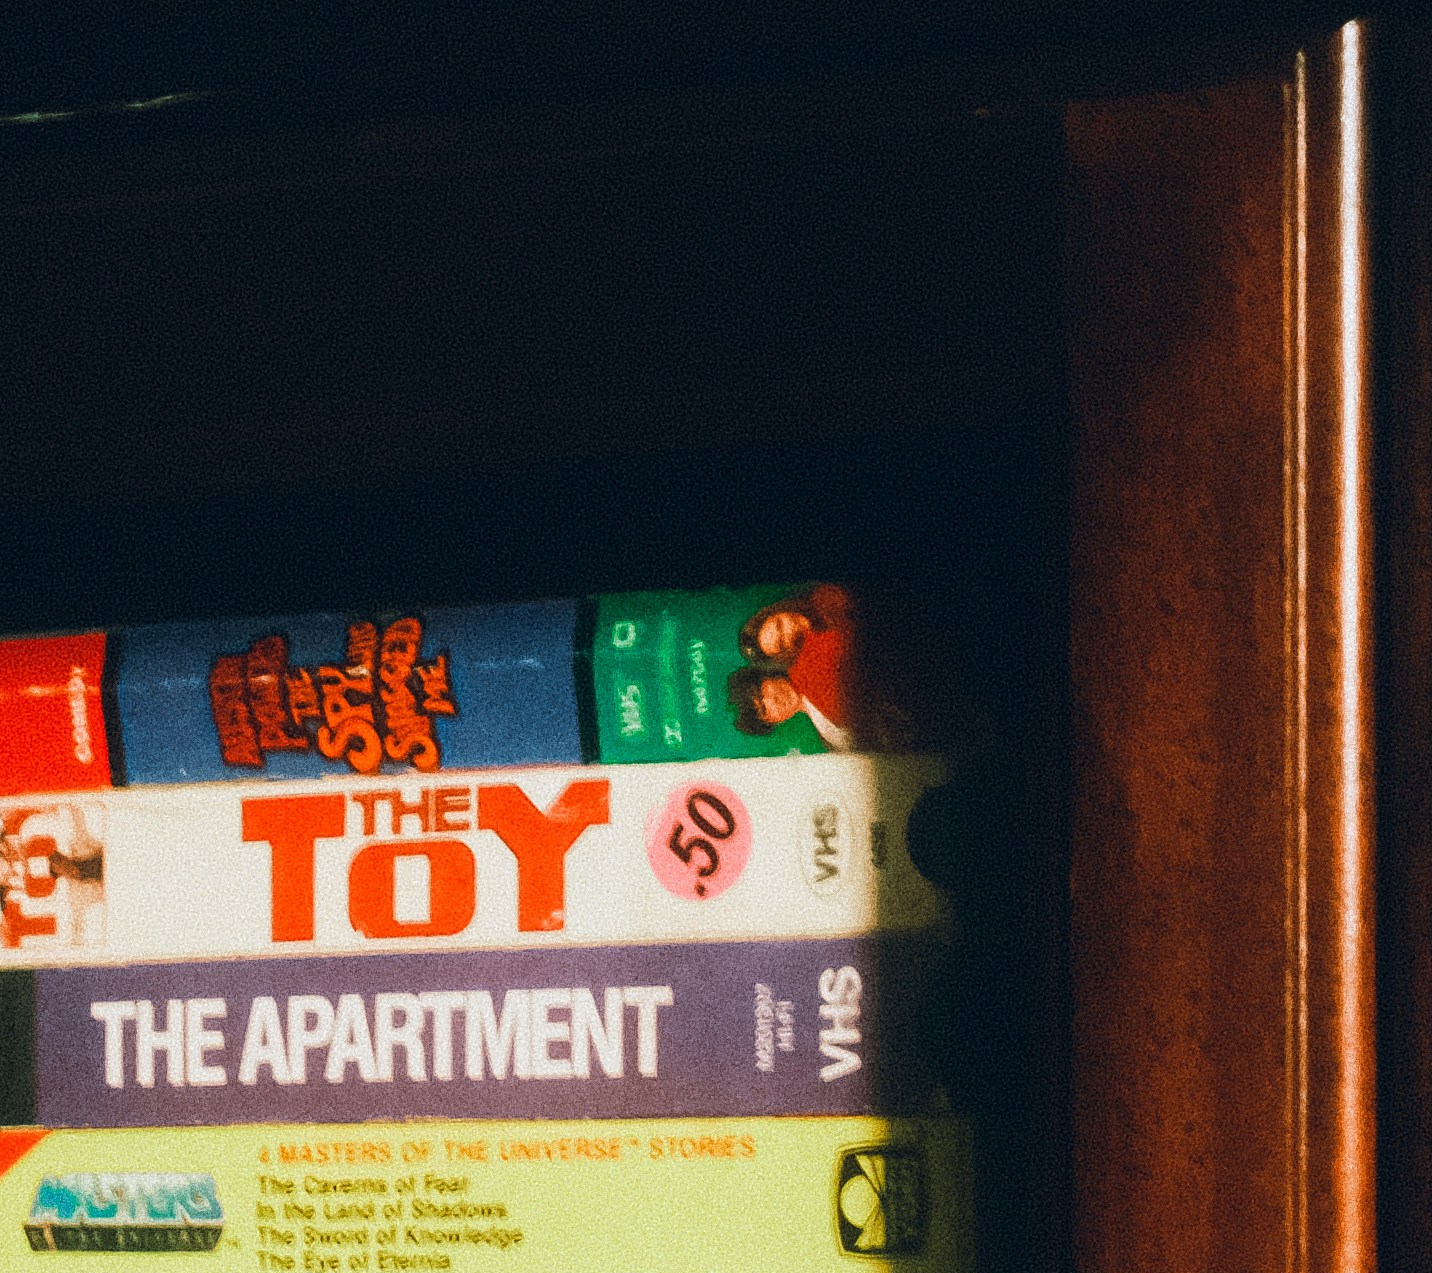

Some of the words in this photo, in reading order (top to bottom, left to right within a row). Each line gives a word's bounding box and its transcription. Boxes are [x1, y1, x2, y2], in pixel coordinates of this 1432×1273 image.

[414, 655, 455, 715] ME
[317, 665, 383, 773] SPY
[351, 787, 471, 836] THE
[242, 779, 611, 943] TOY
[667, 790, 738, 898] .50
[812, 804, 840, 883] VHS
[91, 999, 228, 1089] THE
[238, 984, 674, 1085] APARTMENT
[819, 965, 864, 1082] VHS
[279, 1141, 392, 1165] MASTERS
[403, 1141, 432, 1163] OF
[445, 1139, 491, 1161] THE
[648, 1135, 757, 1160] STORIES
[256, 1175, 294, 1195] The
[304, 1175, 388, 1196] Caverns
[395, 1175, 417, 1195] of
[422, 1173, 471, 1195] Fear
[256, 1201, 276, 1221] In
[283, 1201, 316, 1221] the
[324, 1201, 375, 1221] Land
[383, 1201, 406, 1221] of
[412, 1201, 509, 1221] Shadows
[256, 1226, 294, 1247] The
[302, 1226, 368, 1247] Sword
[375, 1226, 398, 1246] of
[404, 1226, 524, 1250] Knowledge
[256, 1251, 294, 1272] The
[349, 1251, 371, 1271] of
[377, 1250, 452, 1272] Eternia
